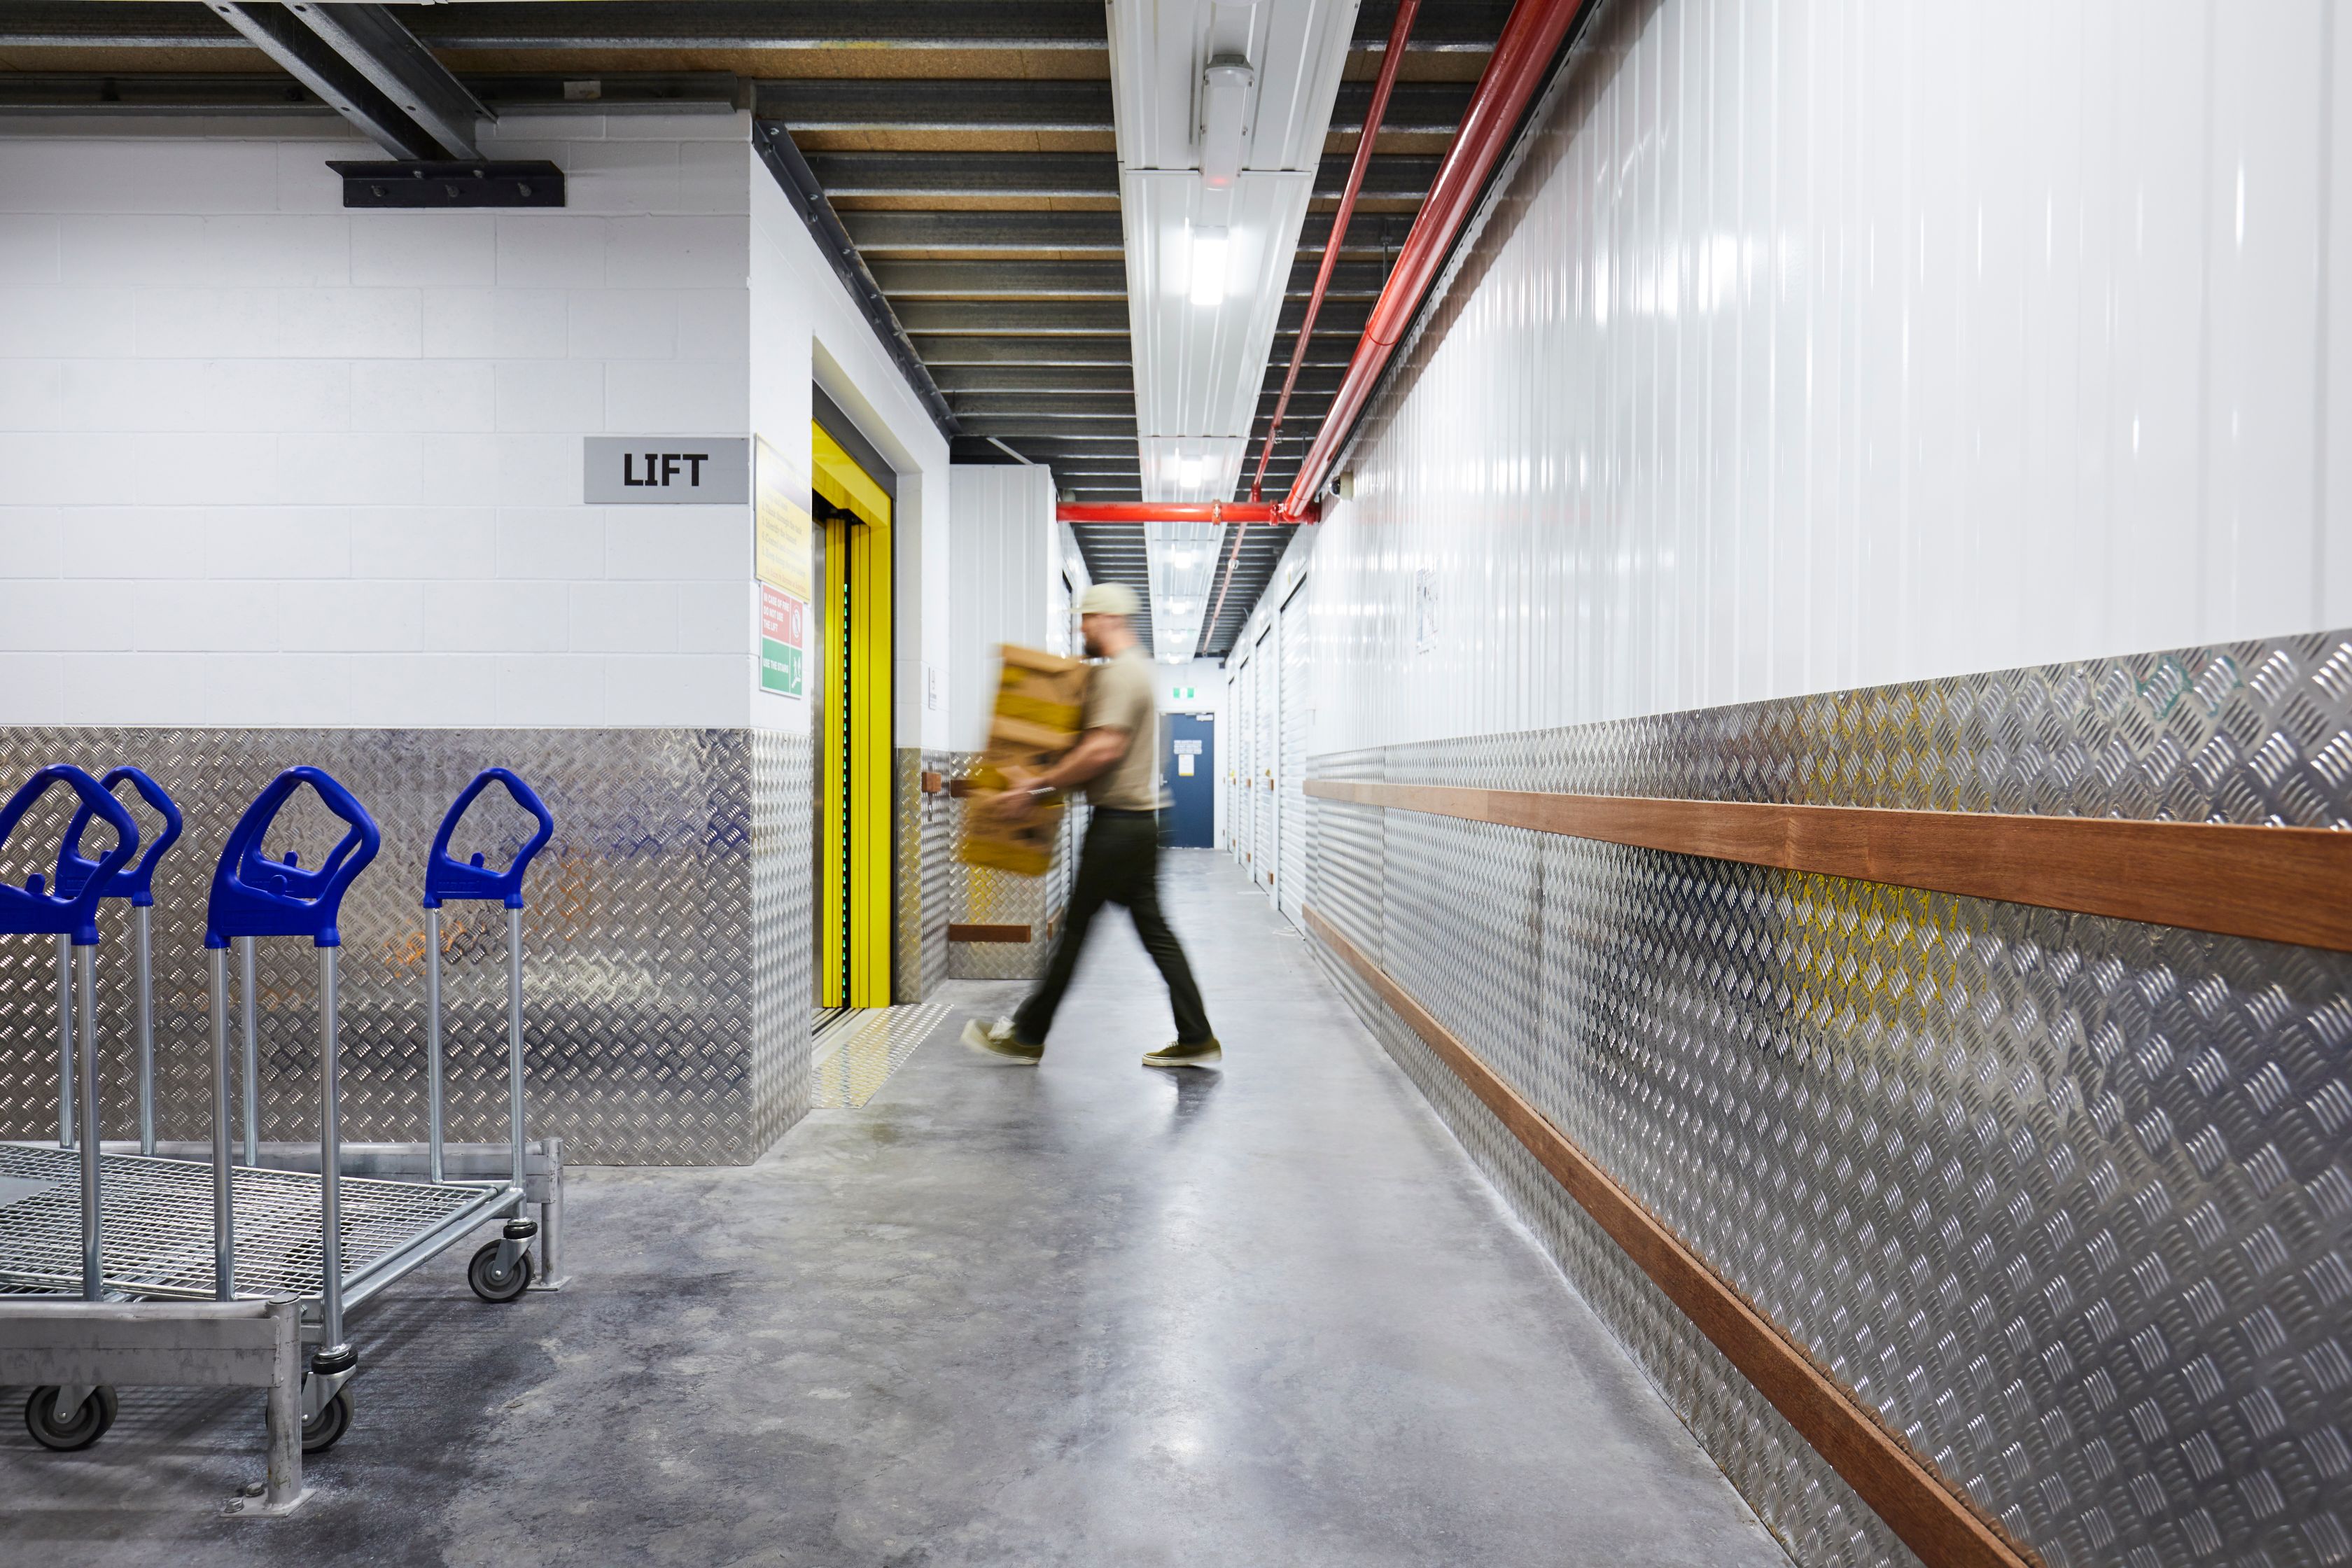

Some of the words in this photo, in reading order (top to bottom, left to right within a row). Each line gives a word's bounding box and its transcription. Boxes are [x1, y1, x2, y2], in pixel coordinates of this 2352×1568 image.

[624, 454, 708, 486] LIFT
[768, 594, 777, 607] CASE
[777, 598, 783, 609] OF
[764, 605, 769, 616] DO
[777, 662, 789, 673] STAIRS
